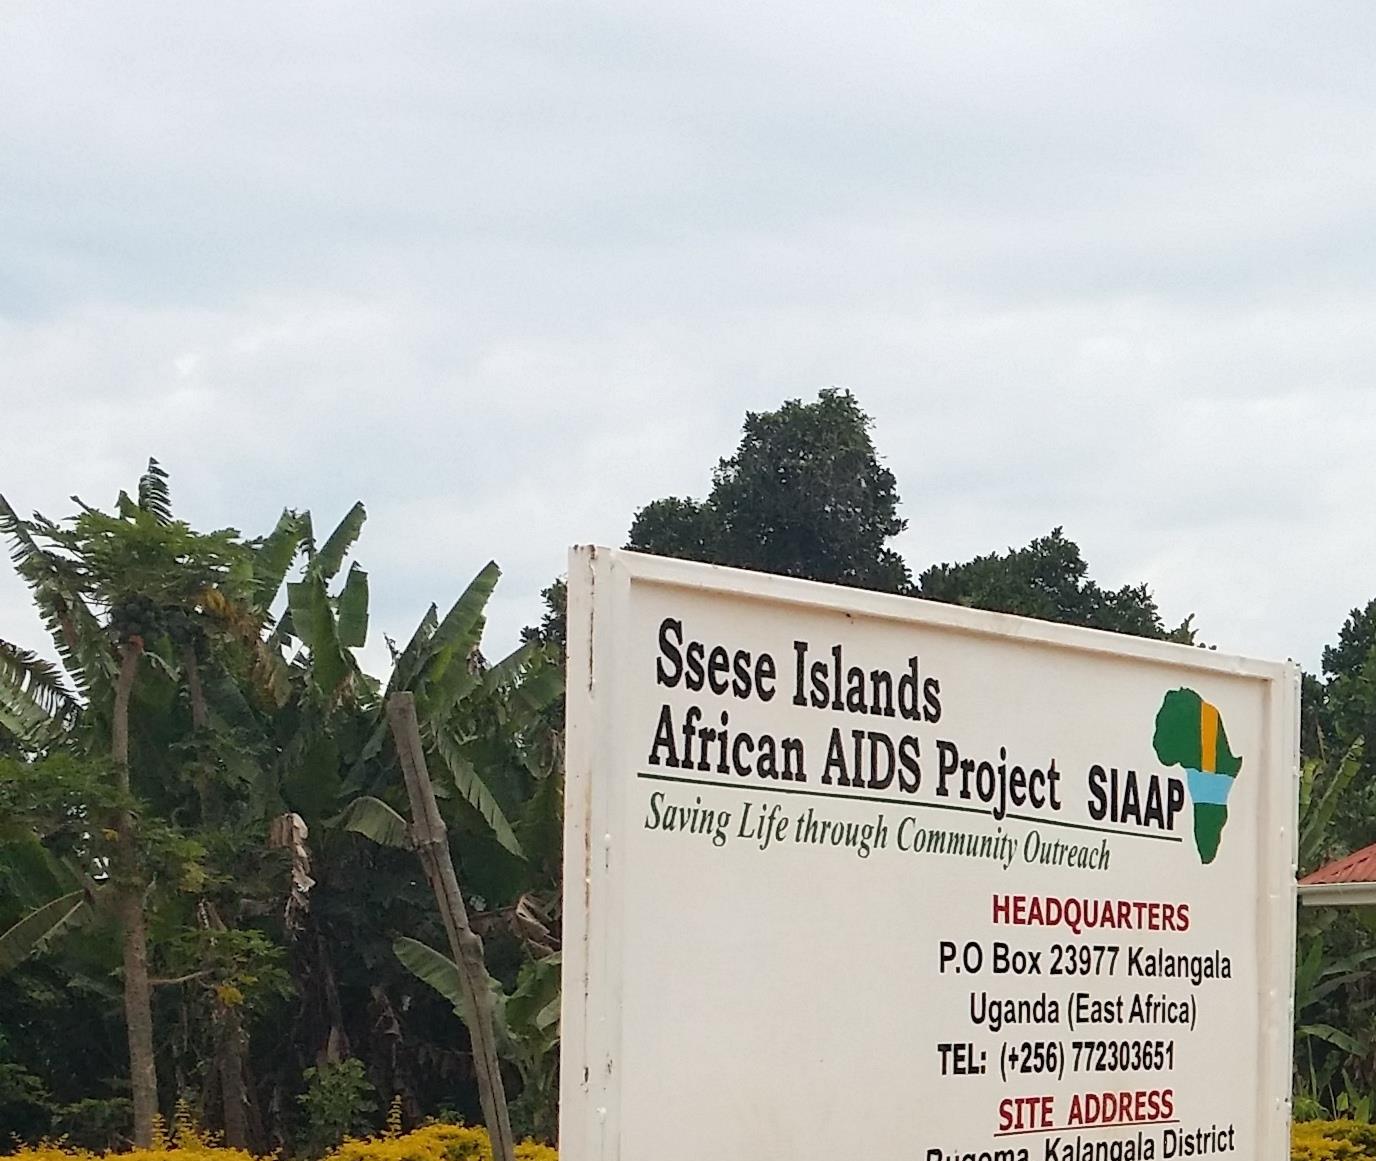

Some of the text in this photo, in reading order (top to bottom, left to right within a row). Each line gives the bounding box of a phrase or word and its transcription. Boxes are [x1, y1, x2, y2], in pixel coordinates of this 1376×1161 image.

[656, 617, 942, 724] Ssese Islands
[648, 704, 1061, 819] African AIDS Project
[1087, 765, 1185, 831] SIAAP
[644, 793, 1111, 872] Saving Life through Community Outreach
[992, 894, 1190, 934] HEADQUARTERS
[939, 941, 1232, 986] P.O Box 23977 Kalangala
[970, 992, 1197, 1032] Uganda (East Africa)
[937, 1040, 1174, 1082] TEL: (+256) 772303651
[999, 1089, 1174, 1131] SITE ADDRESS
[1163, 1124, 1236, 1159] District
